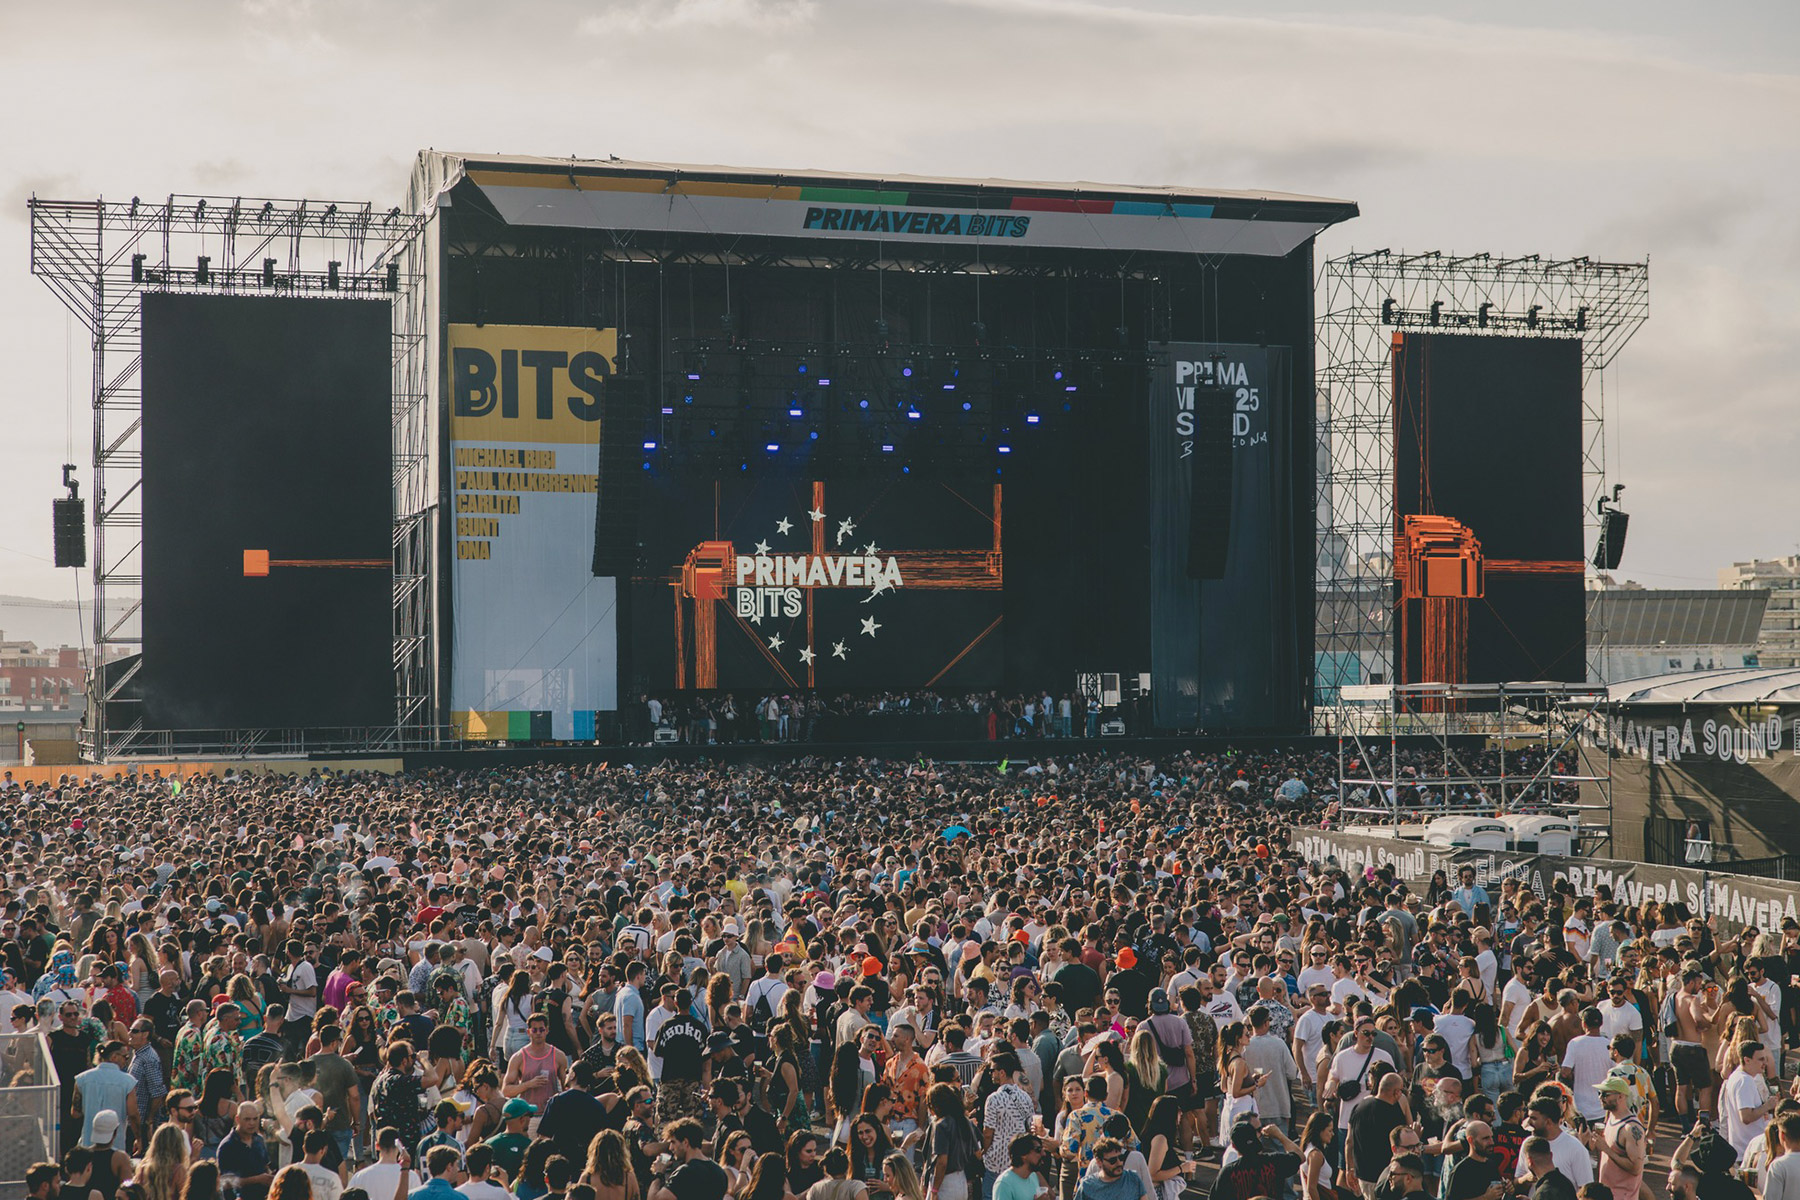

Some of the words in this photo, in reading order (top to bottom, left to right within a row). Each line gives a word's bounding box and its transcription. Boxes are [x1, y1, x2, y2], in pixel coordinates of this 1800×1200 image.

[803, 206, 962, 235] PRIMAVERA
[966, 214, 1032, 238] BITS
[452, 347, 611, 422] BITS
[455, 448, 521, 468] MICHAEL
[524, 450, 556, 469] BIBI
[456, 471, 497, 490] PAUL
[456, 494, 520, 514] CARLITA
[456, 517, 499, 537] BUNT
[736, 556, 904, 586] PRIMAVERA
[736, 587, 802, 618] BITS
[1703, 714, 1782, 765] SOUND
